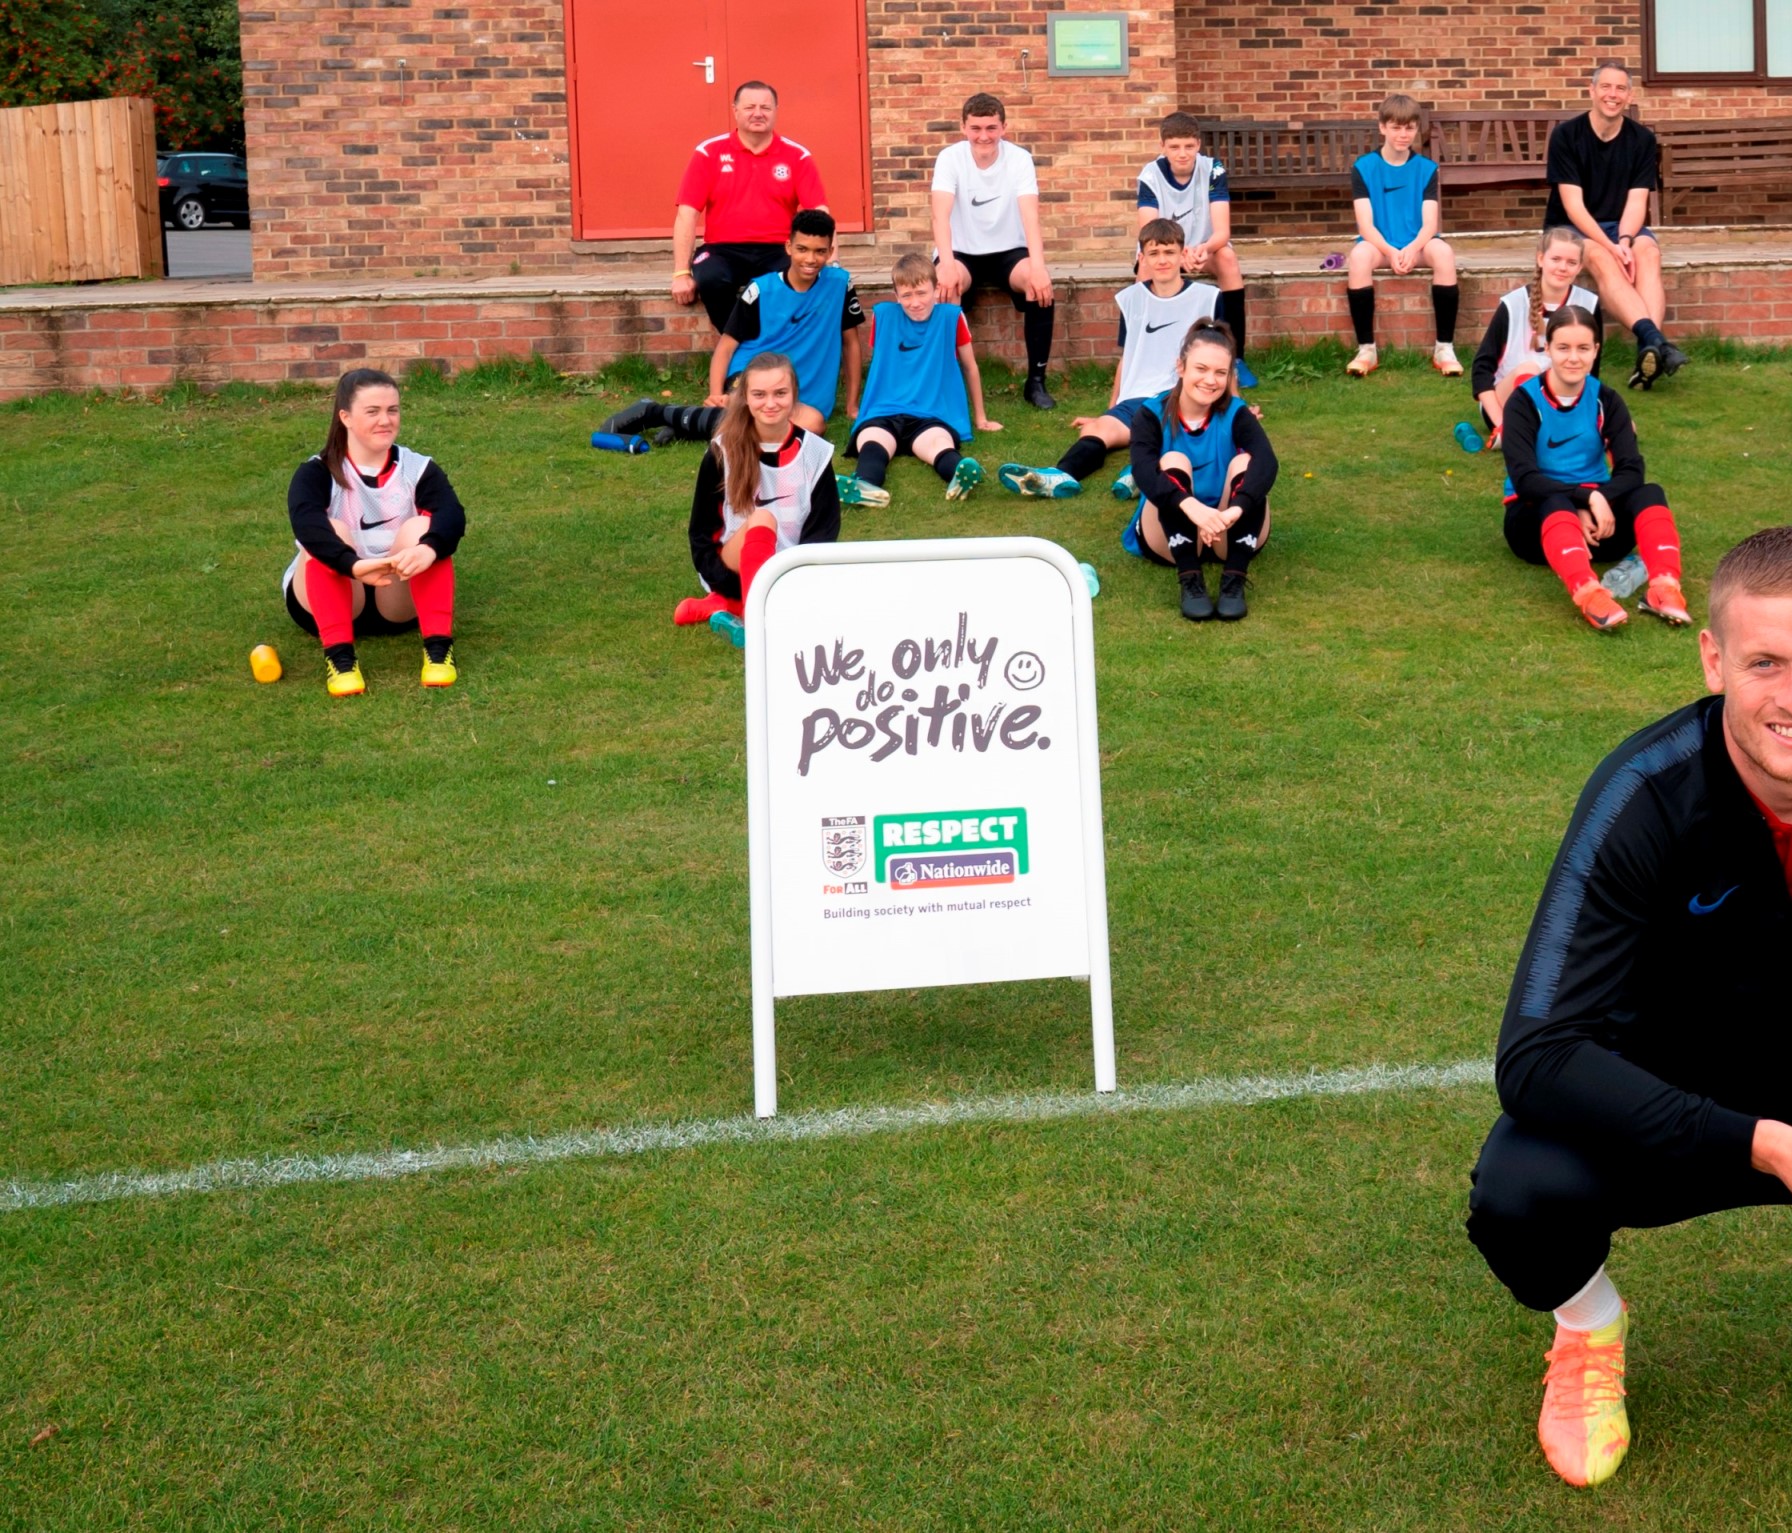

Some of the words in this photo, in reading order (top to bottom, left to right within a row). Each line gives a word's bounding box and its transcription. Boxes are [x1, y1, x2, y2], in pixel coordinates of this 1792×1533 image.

[794, 636, 866, 694] We
[892, 611, 999, 690] only
[855, 669, 895, 711] do
[797, 683, 1051, 777] positive.
[882, 816, 1018, 847] RESPECT
[920, 859, 1010, 880] Nationwide
[845, 883, 867, 894] ALL
[824, 908, 870, 919] Building
[874, 904, 914, 917] society
[918, 903, 943, 914] with
[947, 899, 986, 911] mutual
[990, 897, 1031, 909] respect
